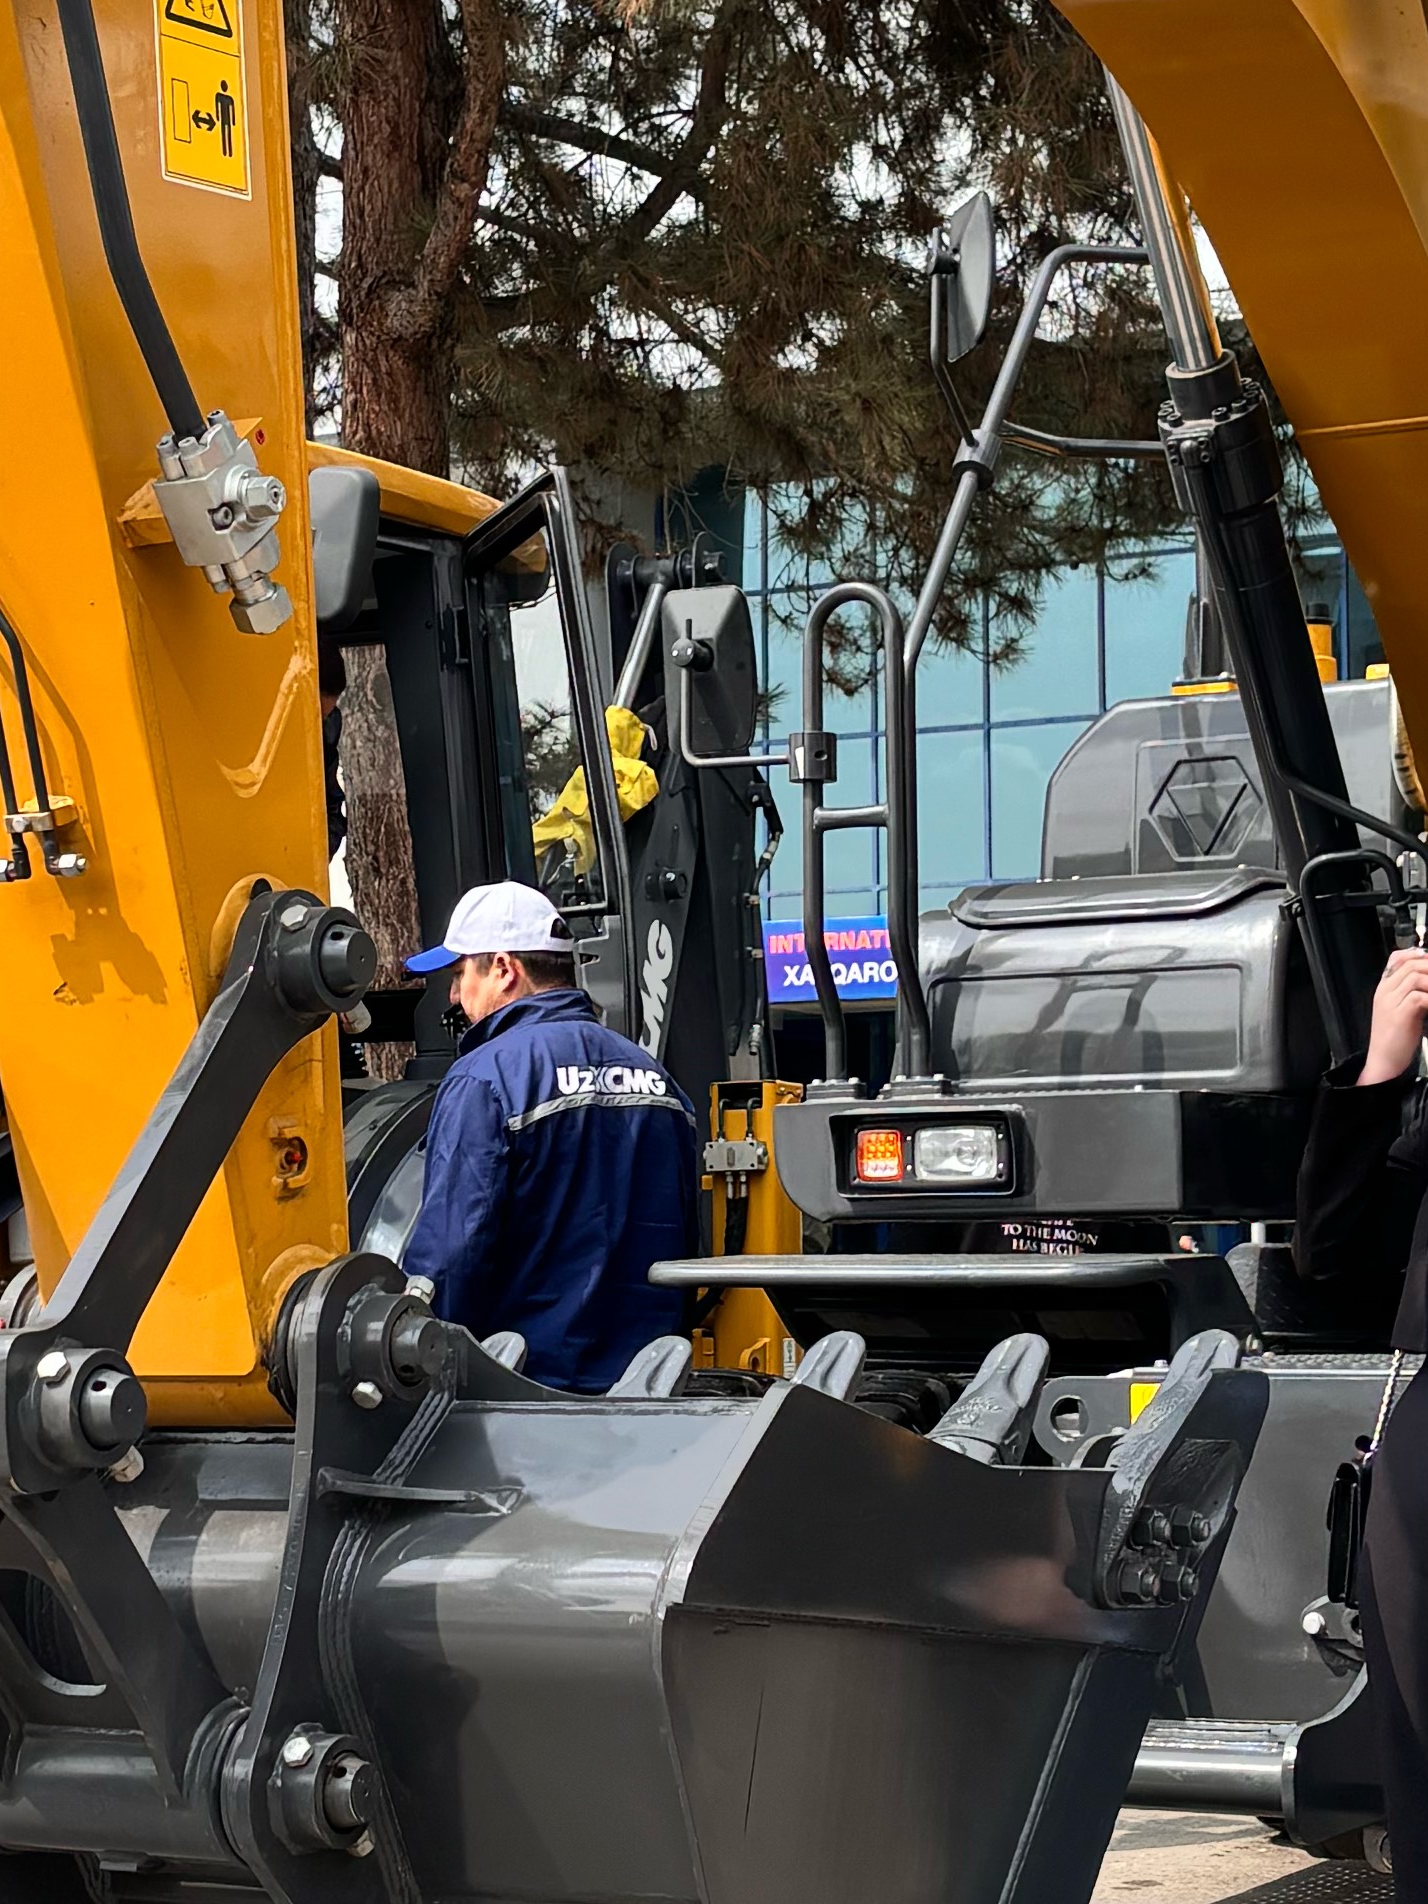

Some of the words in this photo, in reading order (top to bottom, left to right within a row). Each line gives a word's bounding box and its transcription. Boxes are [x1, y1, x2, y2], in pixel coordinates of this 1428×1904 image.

[783, 960, 898, 987] XAQARO
[1001, 1223, 1022, 1235] TO
[1024, 1224, 1051, 1239] THE
[1053, 1228, 1098, 1245] MOON
